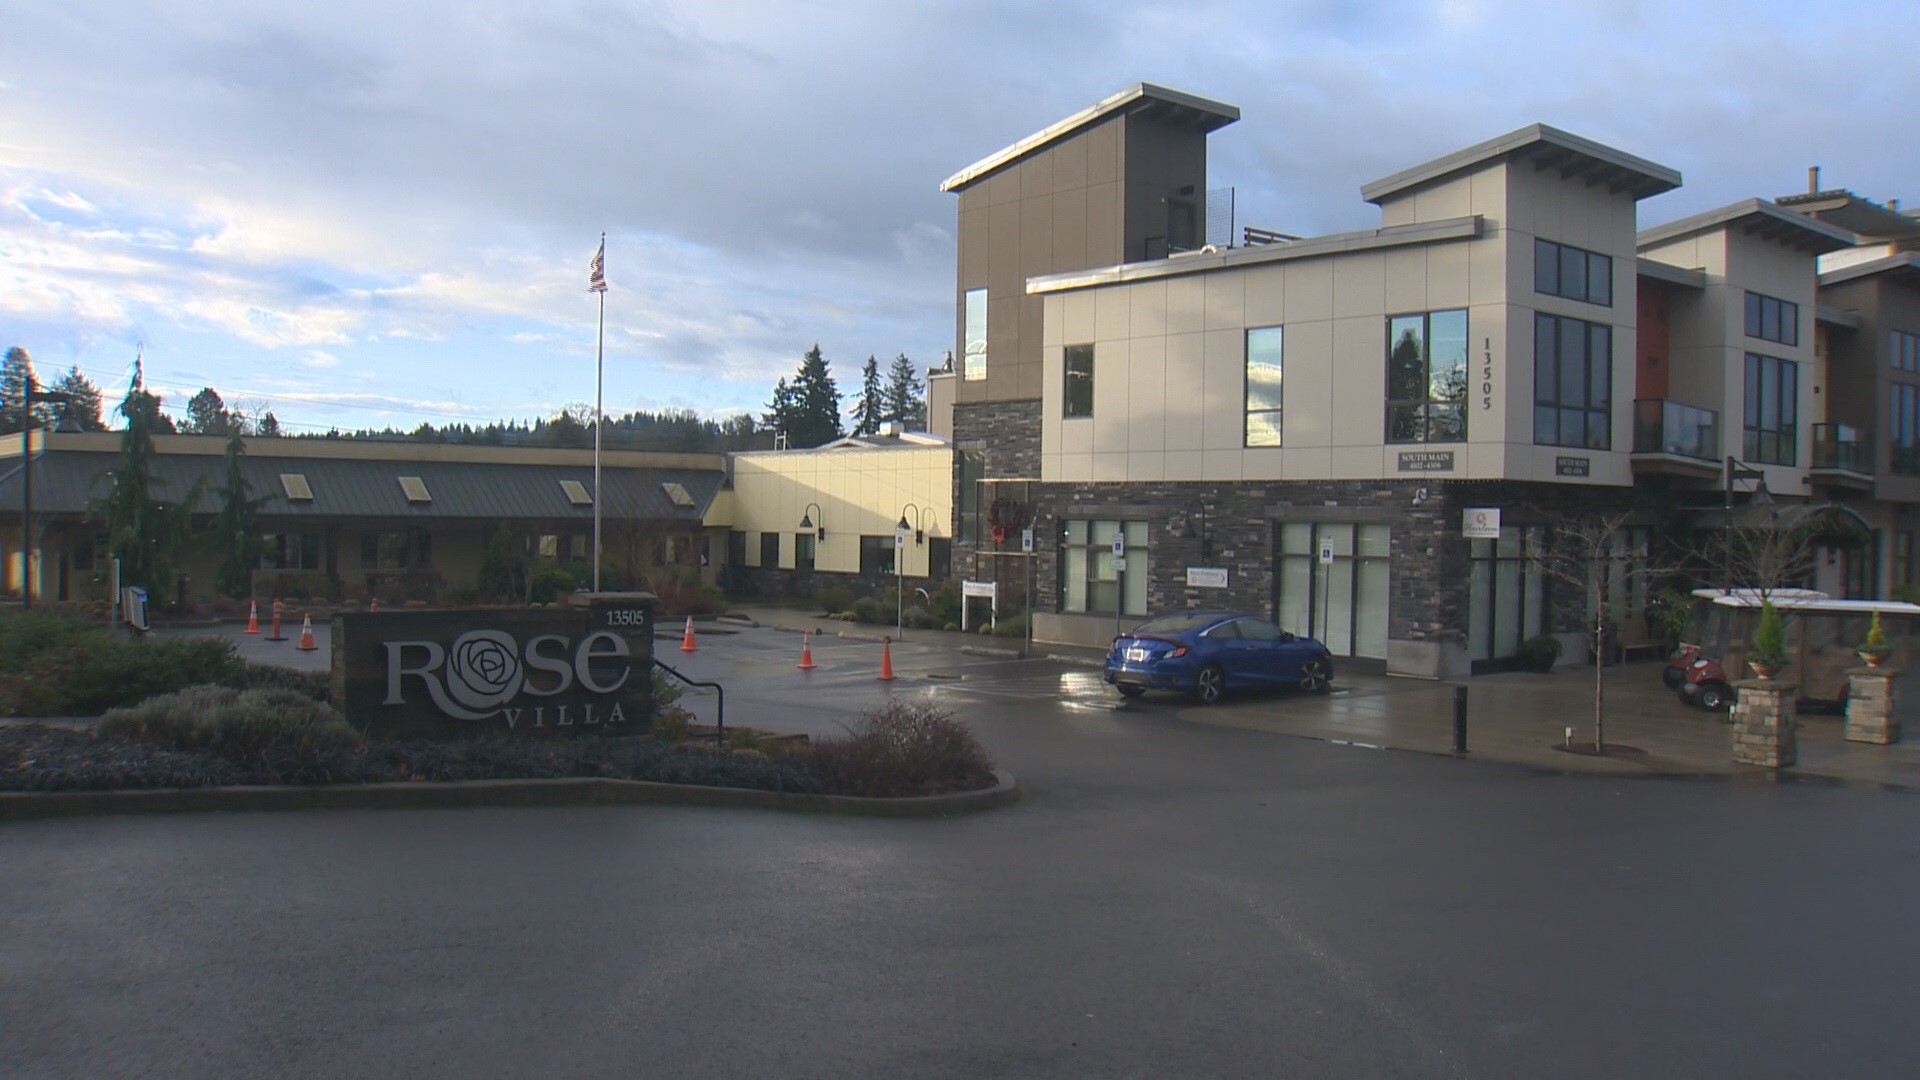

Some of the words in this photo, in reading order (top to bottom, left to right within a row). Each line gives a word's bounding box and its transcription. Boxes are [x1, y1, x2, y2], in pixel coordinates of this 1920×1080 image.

[1482, 336, 1492, 411] 13505
[1402, 453, 1427, 462] SOUTH
[1428, 452, 1450, 461] MAIN
[606, 610, 644, 625] 13505
[503, 702, 626, 729] VILLA
